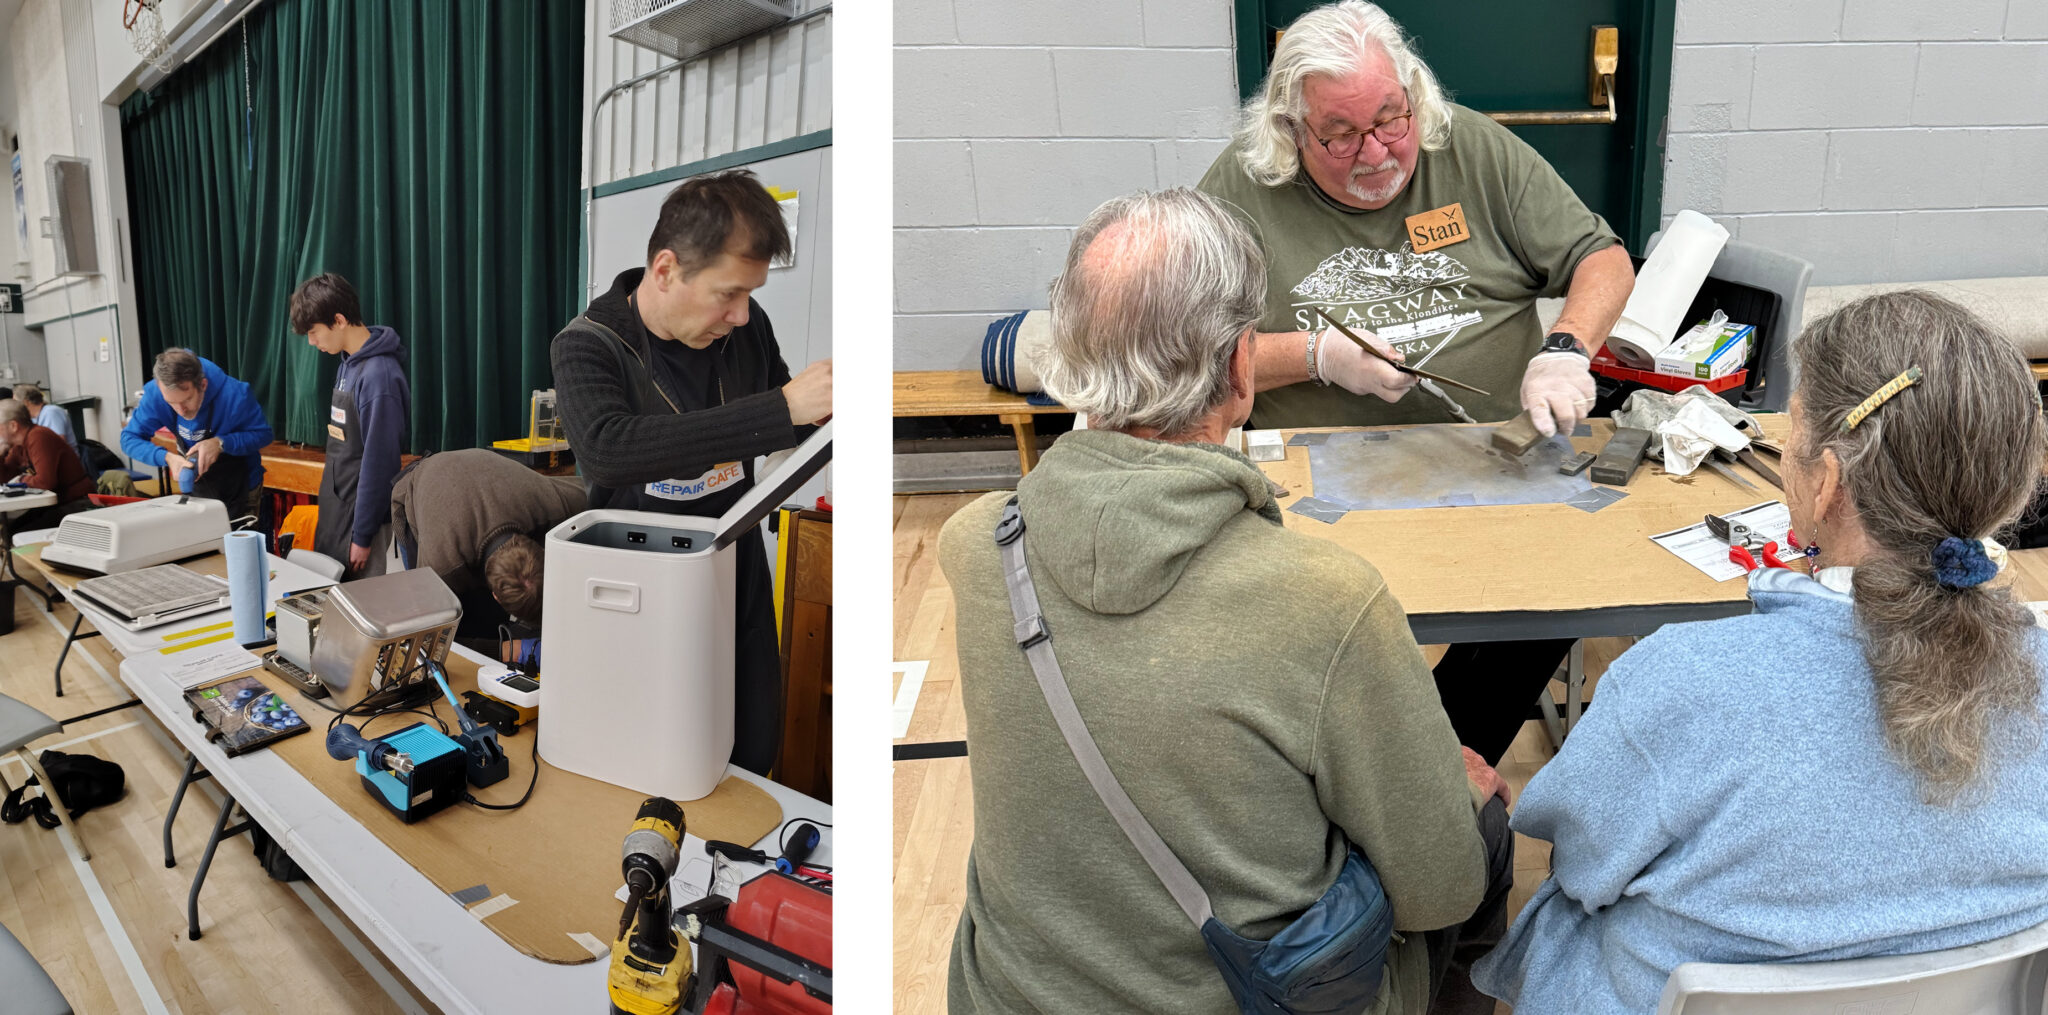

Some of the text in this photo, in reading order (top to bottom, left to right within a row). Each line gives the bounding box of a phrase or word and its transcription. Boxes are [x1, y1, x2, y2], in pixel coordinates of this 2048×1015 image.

[1413, 221, 1463, 246] Stan
[1295, 284, 1468, 332] SKAGWAY
[1386, 317, 1403, 325] the
[1406, 304, 1453, 321] Klondike
[1674, 368, 1692, 376] Gloves
[650, 464, 740, 495] REPAIR CAFE
